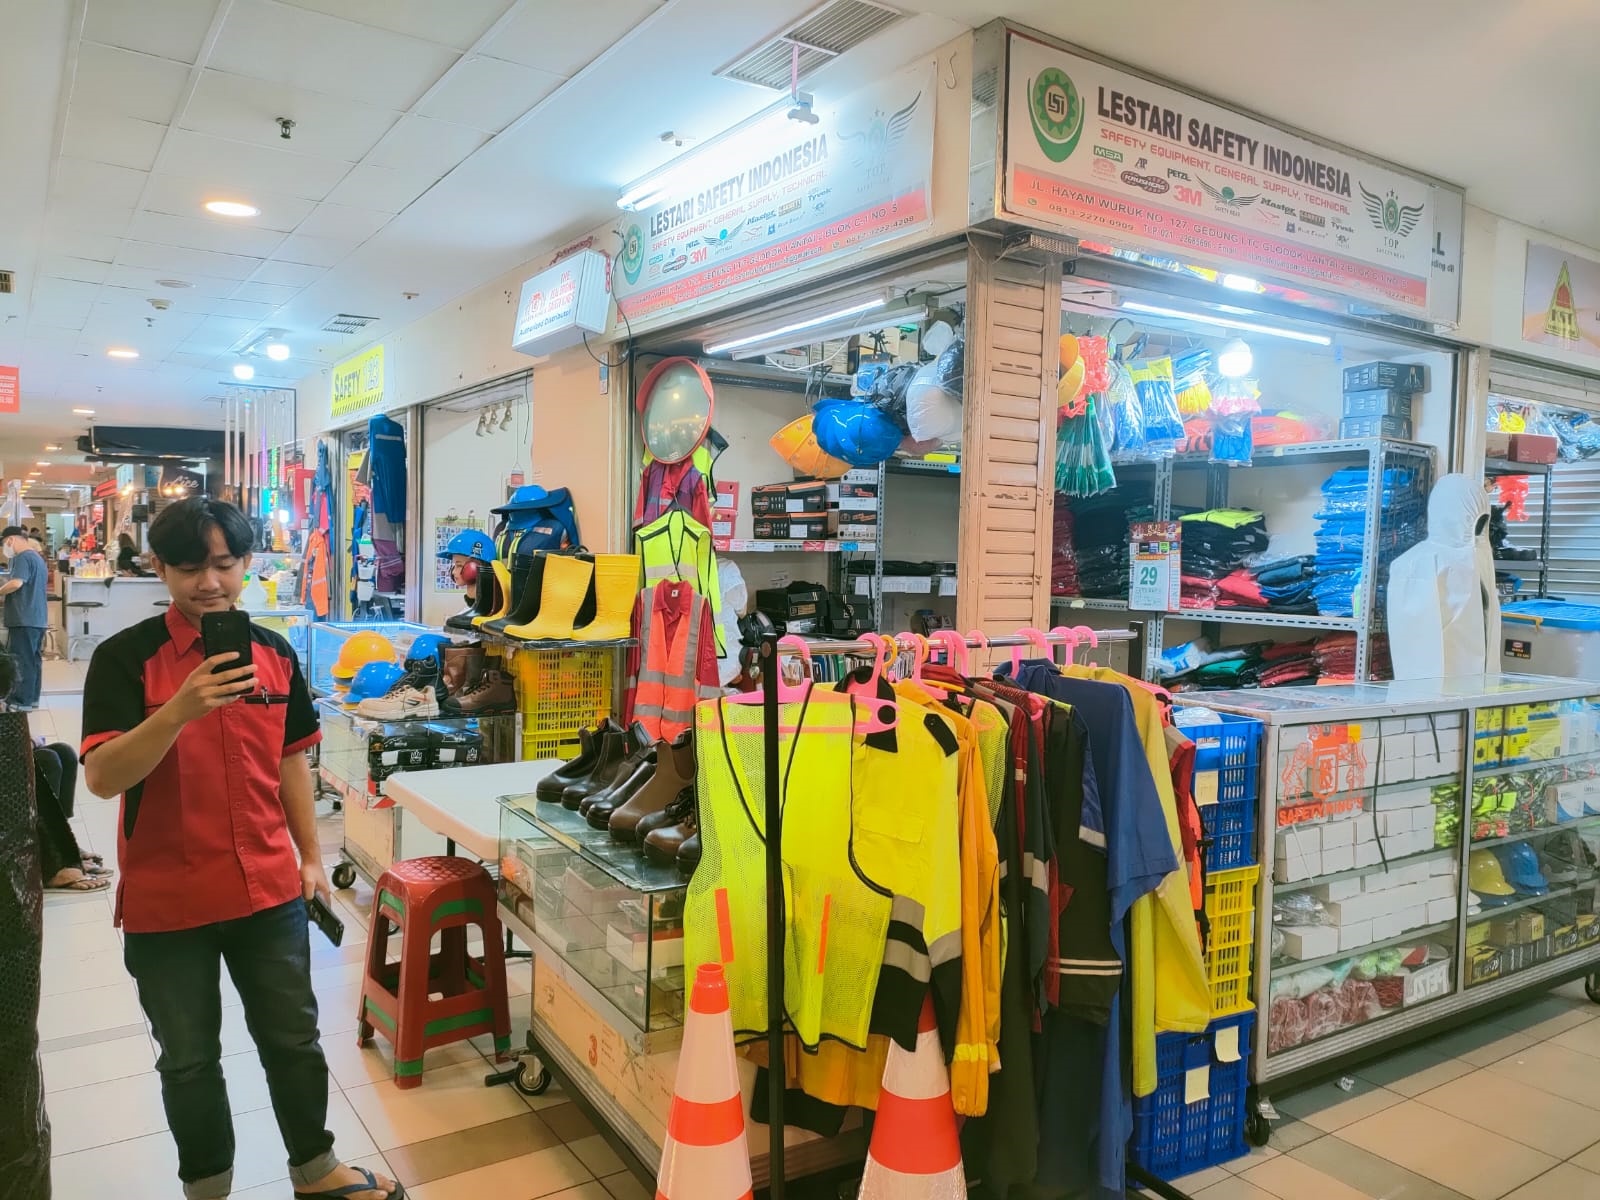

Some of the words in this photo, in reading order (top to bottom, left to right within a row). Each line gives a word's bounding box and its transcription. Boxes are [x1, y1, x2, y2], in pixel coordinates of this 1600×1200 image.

[1095, 147, 1122, 161] MSA
[1098, 86, 1182, 141] LESTARI
[1188, 118, 1259, 165] SAFETY
[1263, 143, 1352, 198] INDONESIA
[650, 197, 694, 237] LESTARI
[697, 172, 745, 215] SAFETY
[749, 133, 829, 193] INDONESIA
[1101, 128, 1146, 150] SAFETY
[1150, 144, 1211, 172] EQUIPMENT,
[1214, 165, 1259, 187] GENERAL
[1304, 193, 1351, 215] TECHNICAL
[652, 235, 675, 252] SAFETY
[782, 170, 828, 195] TECHNICAL
[1174, 185, 1203, 207] 3M
[1052, 186, 1095, 205] HAYAM
[1099, 199, 1143, 218] WURUK
[1193, 224, 1239, 244] GEDUNG
[1262, 243, 1303, 259] GLODOK
[690, 247, 708, 265] 3M
[1383, 236, 1400, 248] TOP
[334, 369, 361, 403] SAFETY
[1140, 566, 1158, 586] 29
[1278, 801, 1324, 827] SAFETY
